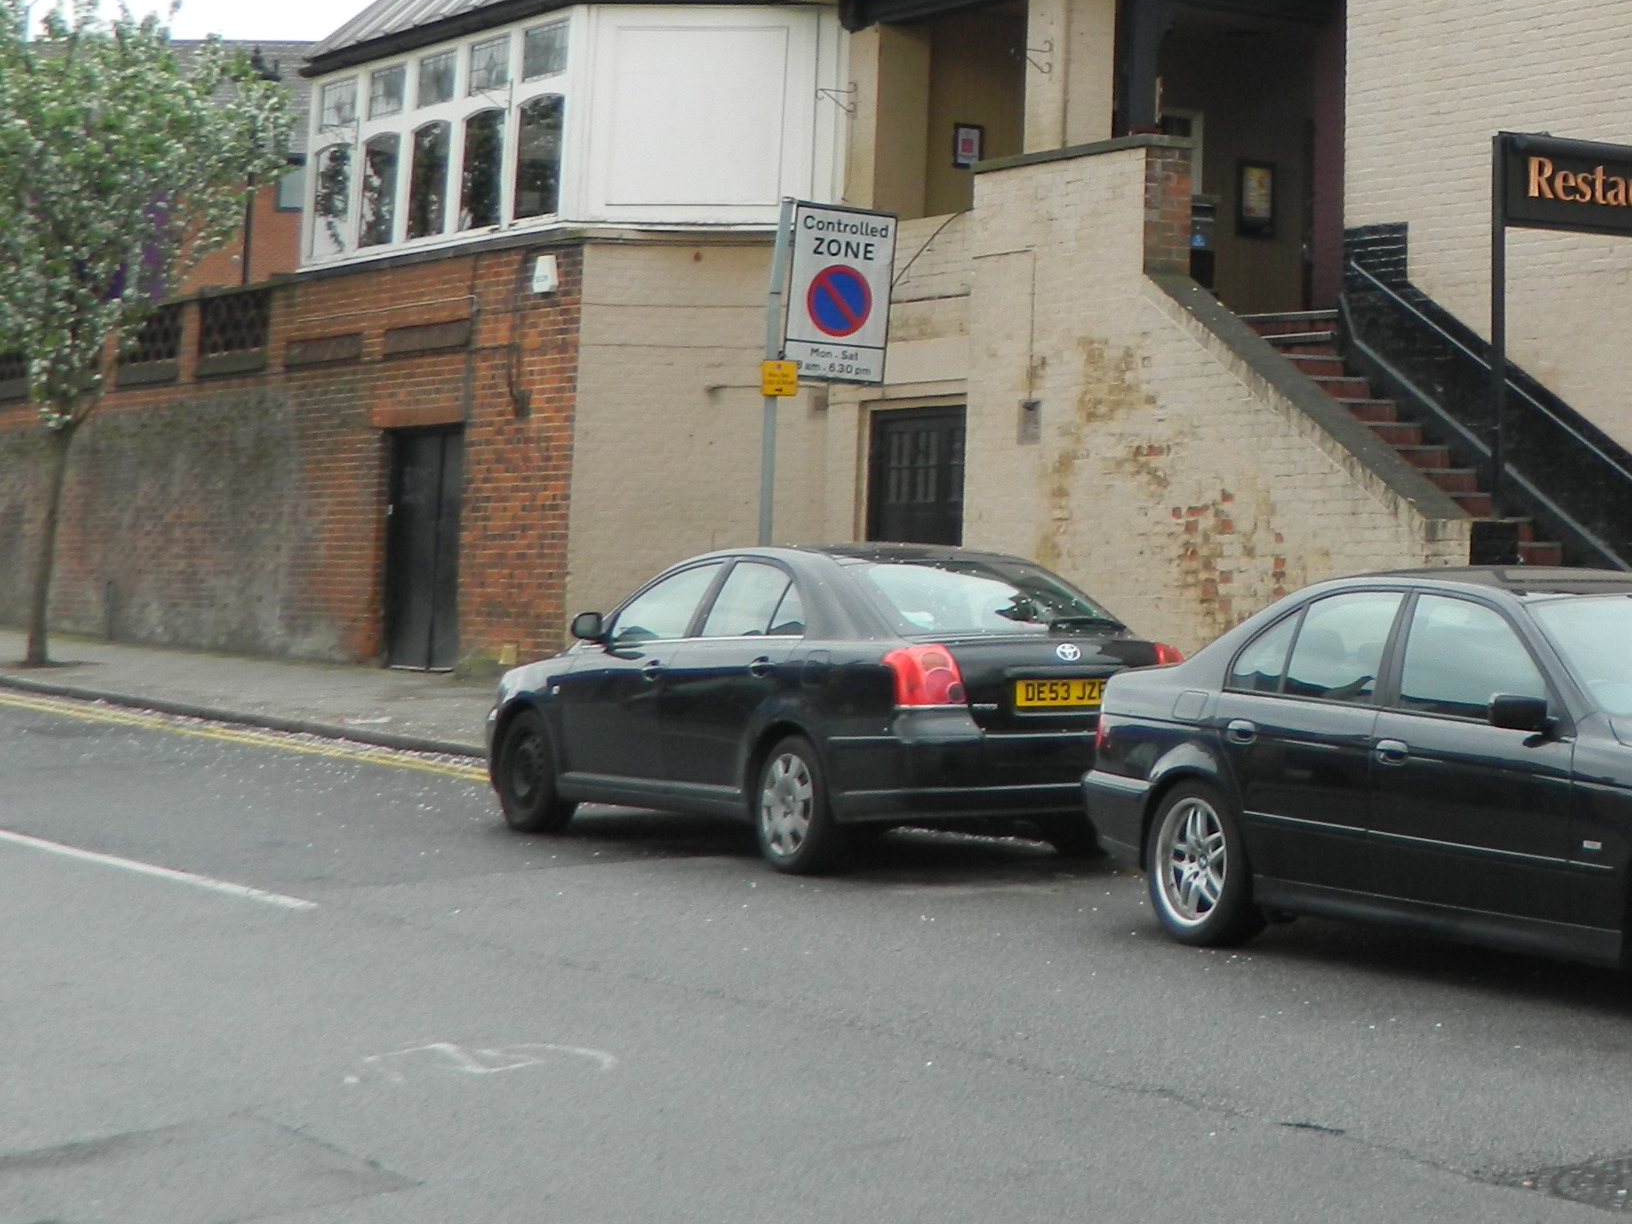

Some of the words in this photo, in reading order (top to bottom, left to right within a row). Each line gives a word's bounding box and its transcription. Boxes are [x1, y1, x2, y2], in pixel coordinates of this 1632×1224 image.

[803, 214, 890, 239] Controlled
[813, 236, 875, 261] ZONE
[810, 347, 833, 359] Mon
[841, 350, 859, 362] Sat
[804, 362, 821, 371] am
[854, 367, 872, 376] pm
[1025, 680, 1070, 702] DE53
